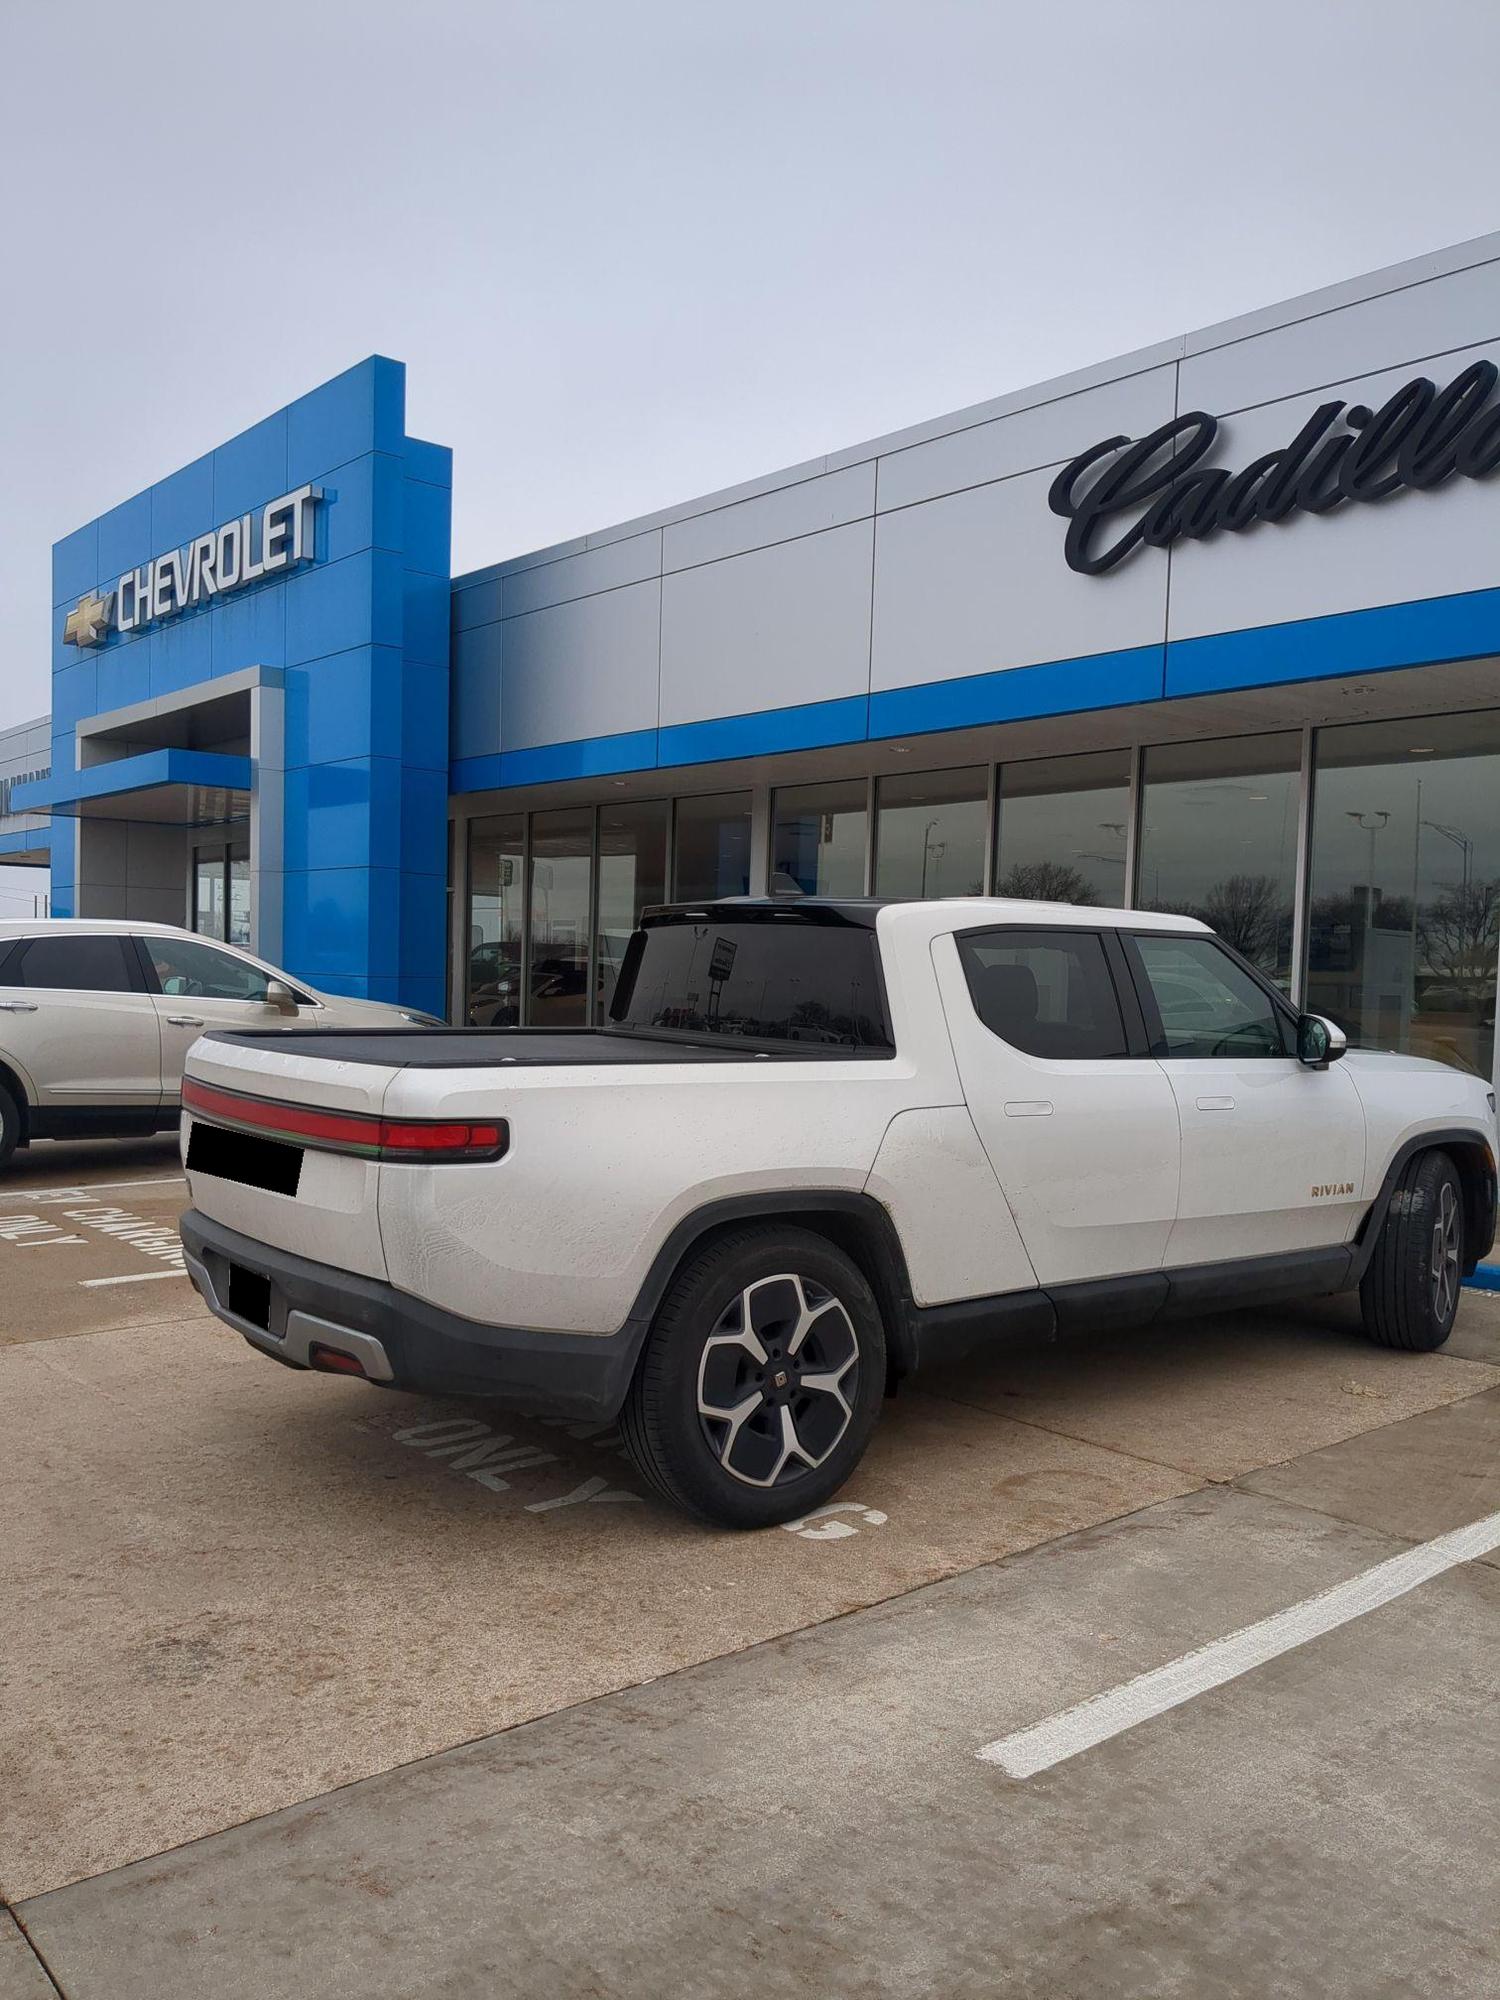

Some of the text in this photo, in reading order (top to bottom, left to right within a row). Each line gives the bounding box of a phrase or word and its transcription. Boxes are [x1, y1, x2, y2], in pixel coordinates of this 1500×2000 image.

[116, 484, 324, 633] CHEVROLET
[1311, 1183, 1354, 1197] RIVIAN
[62, 1207, 187, 1267] CHARGI
[392, 1417, 645, 1513] ONLY
